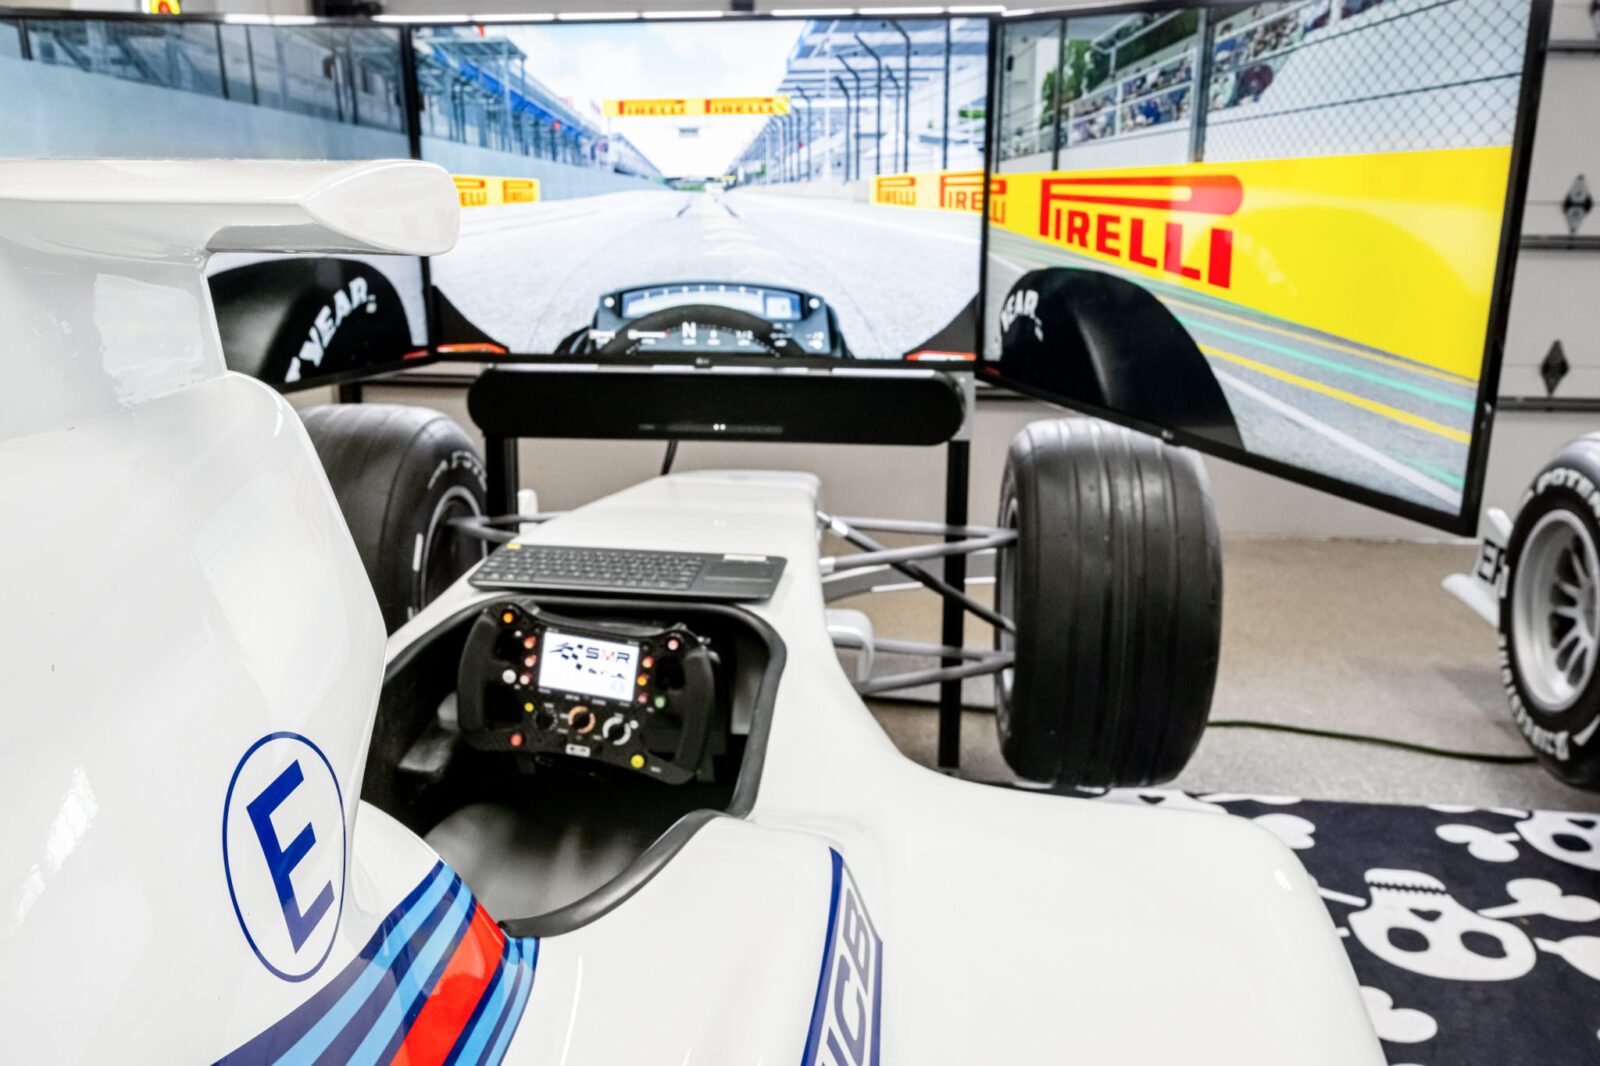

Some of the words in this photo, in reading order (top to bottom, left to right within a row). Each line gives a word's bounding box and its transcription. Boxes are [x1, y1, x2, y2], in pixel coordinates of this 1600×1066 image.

[1040, 174, 1244, 290] PIRELLI
[682, 321, 697, 338] N
[246, 758, 335, 955] E
